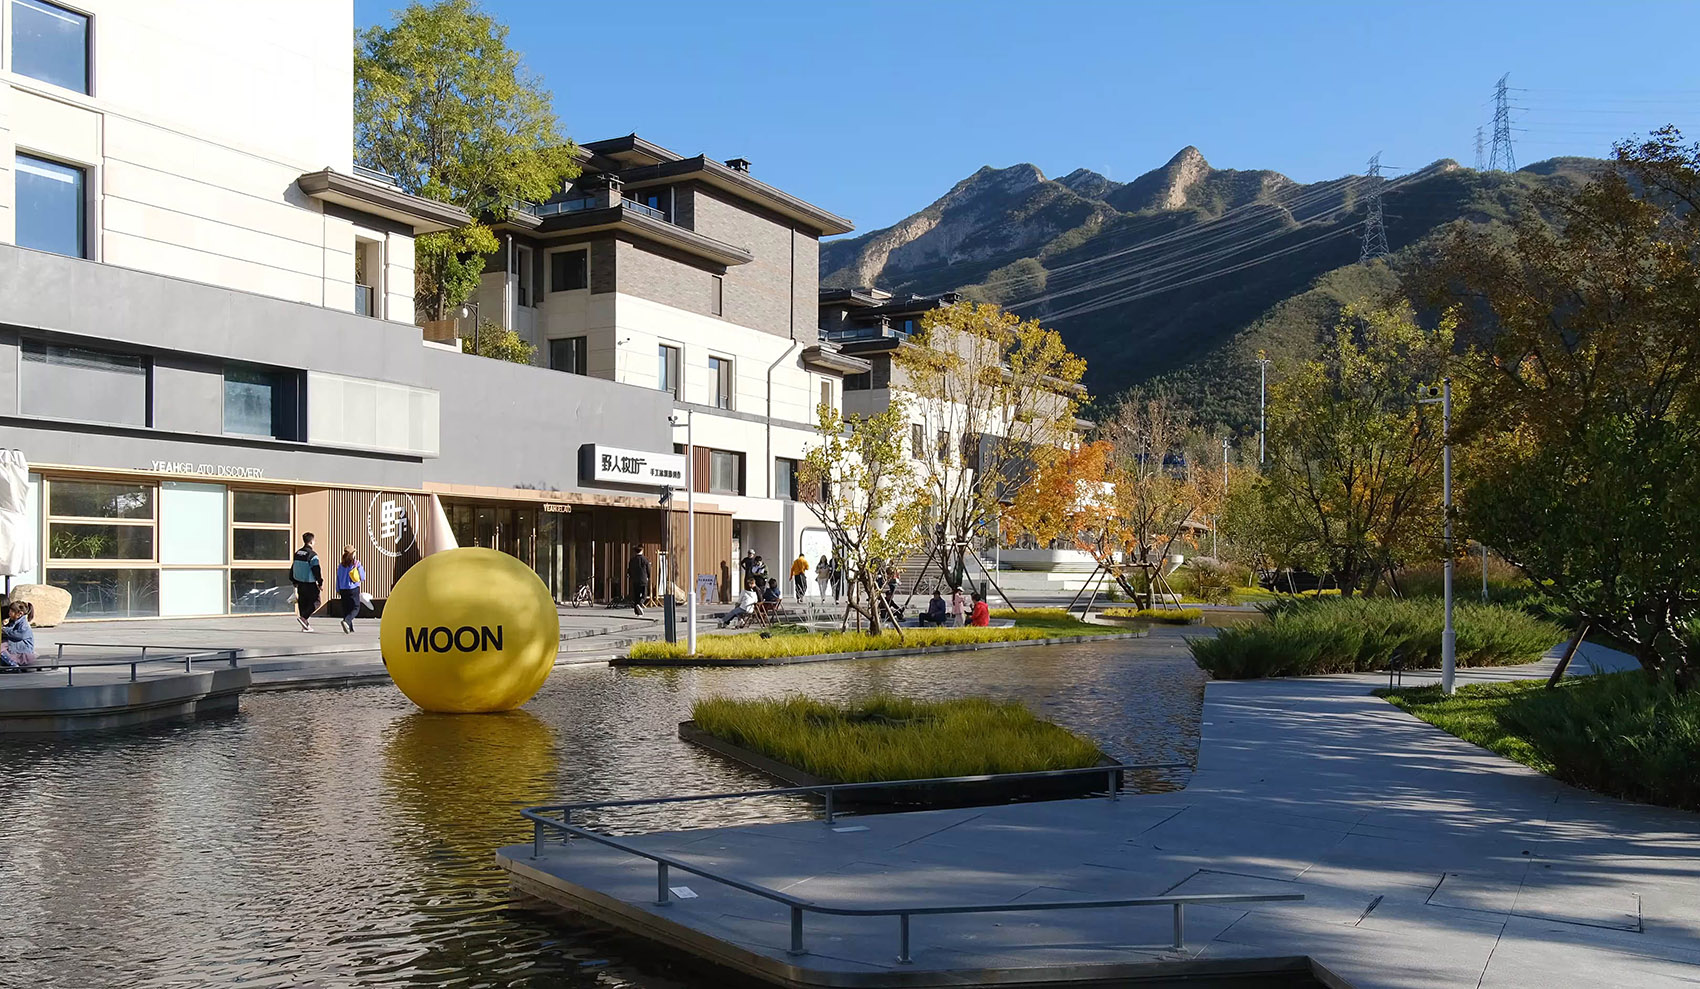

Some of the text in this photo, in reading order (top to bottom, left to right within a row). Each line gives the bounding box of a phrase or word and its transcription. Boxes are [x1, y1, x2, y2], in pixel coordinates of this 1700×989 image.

[217, 465, 264, 478] DISCOVERY
[381, 500, 407, 544] 野
[405, 625, 503, 653] MOON
